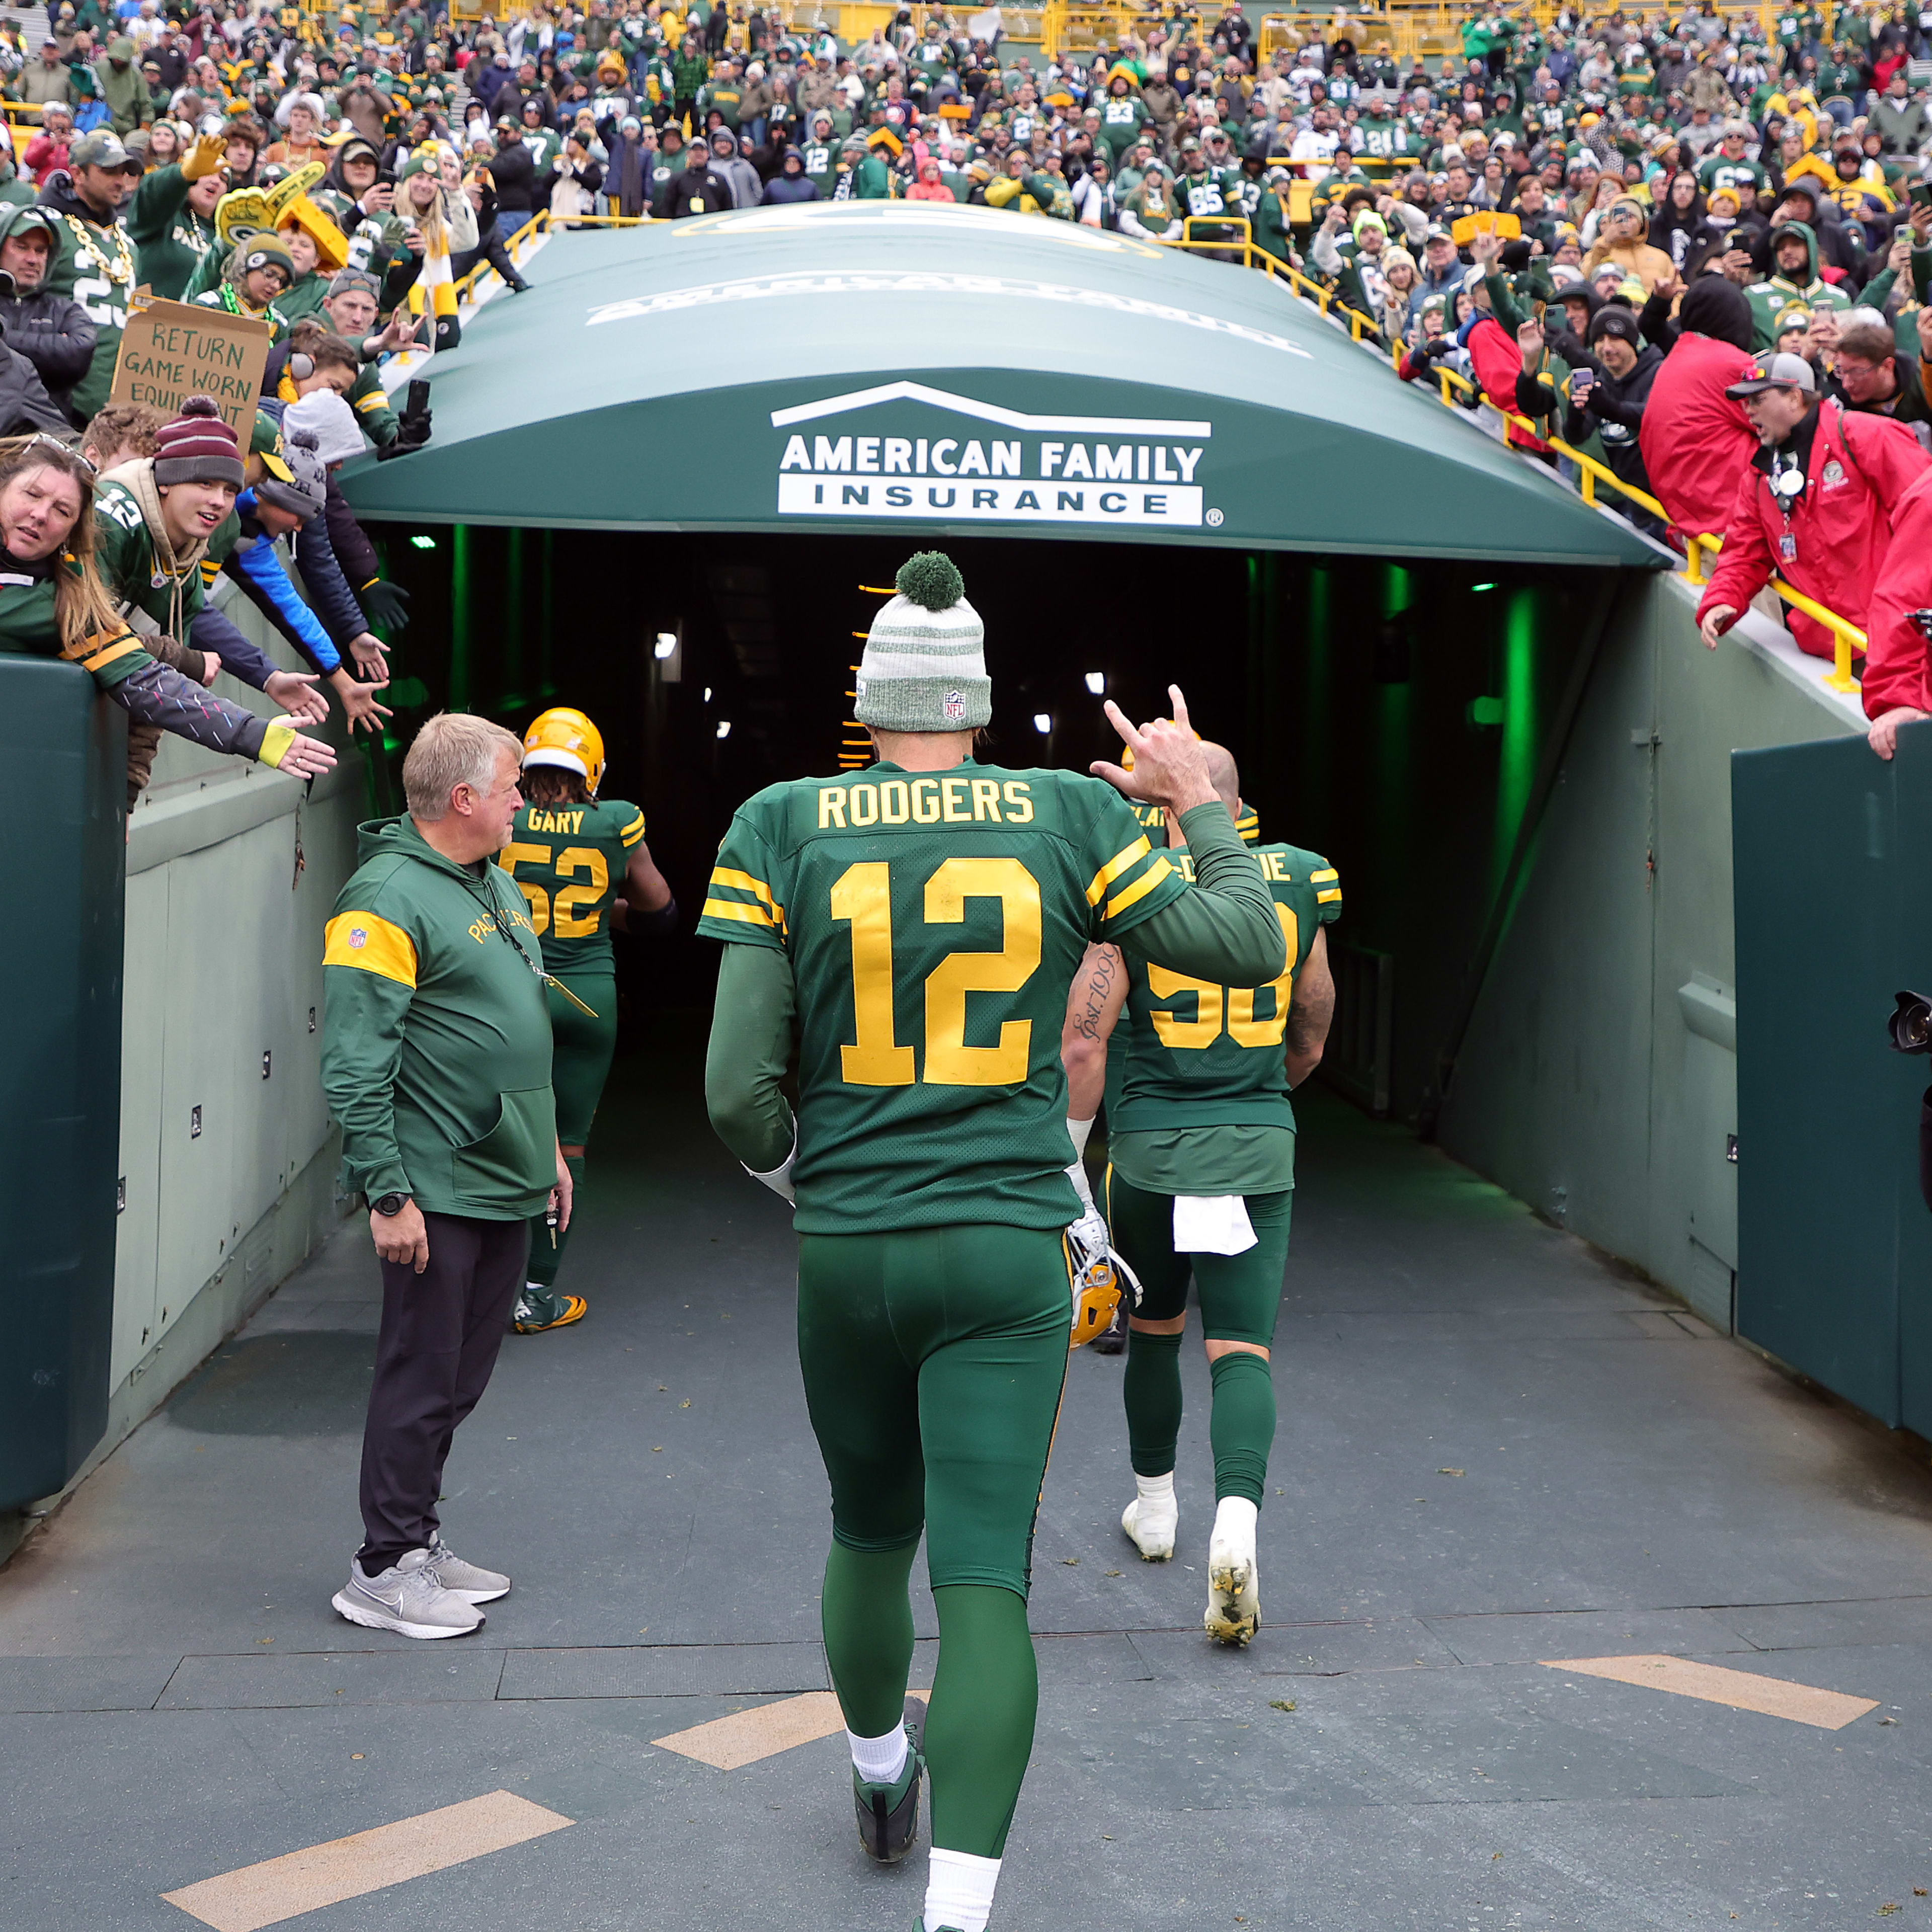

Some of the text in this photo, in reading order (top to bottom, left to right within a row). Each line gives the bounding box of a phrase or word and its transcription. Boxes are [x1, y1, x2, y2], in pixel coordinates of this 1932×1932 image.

[1106, 102, 1134, 124] 23
[805, 147, 829, 174] 12
[1188, 183, 1224, 216] 85
[152, 323, 245, 369] RETURN
[125, 352, 252, 402] GAME WORN
[131, 382, 245, 426] EQUIPNT
[779, 435, 1203, 481] AMERICAN FAMILY
[95, 488, 143, 530] 12
[814, 484, 1168, 514] INSURANCE
[946, 704, 963, 717] NFL
[528, 808, 585, 835] GARY
[818, 778, 1034, 829] RODGERS
[498, 842, 609, 938] 52
[830, 857, 1042, 1086] 12
[1089, 941, 1120, 1000] 1999
